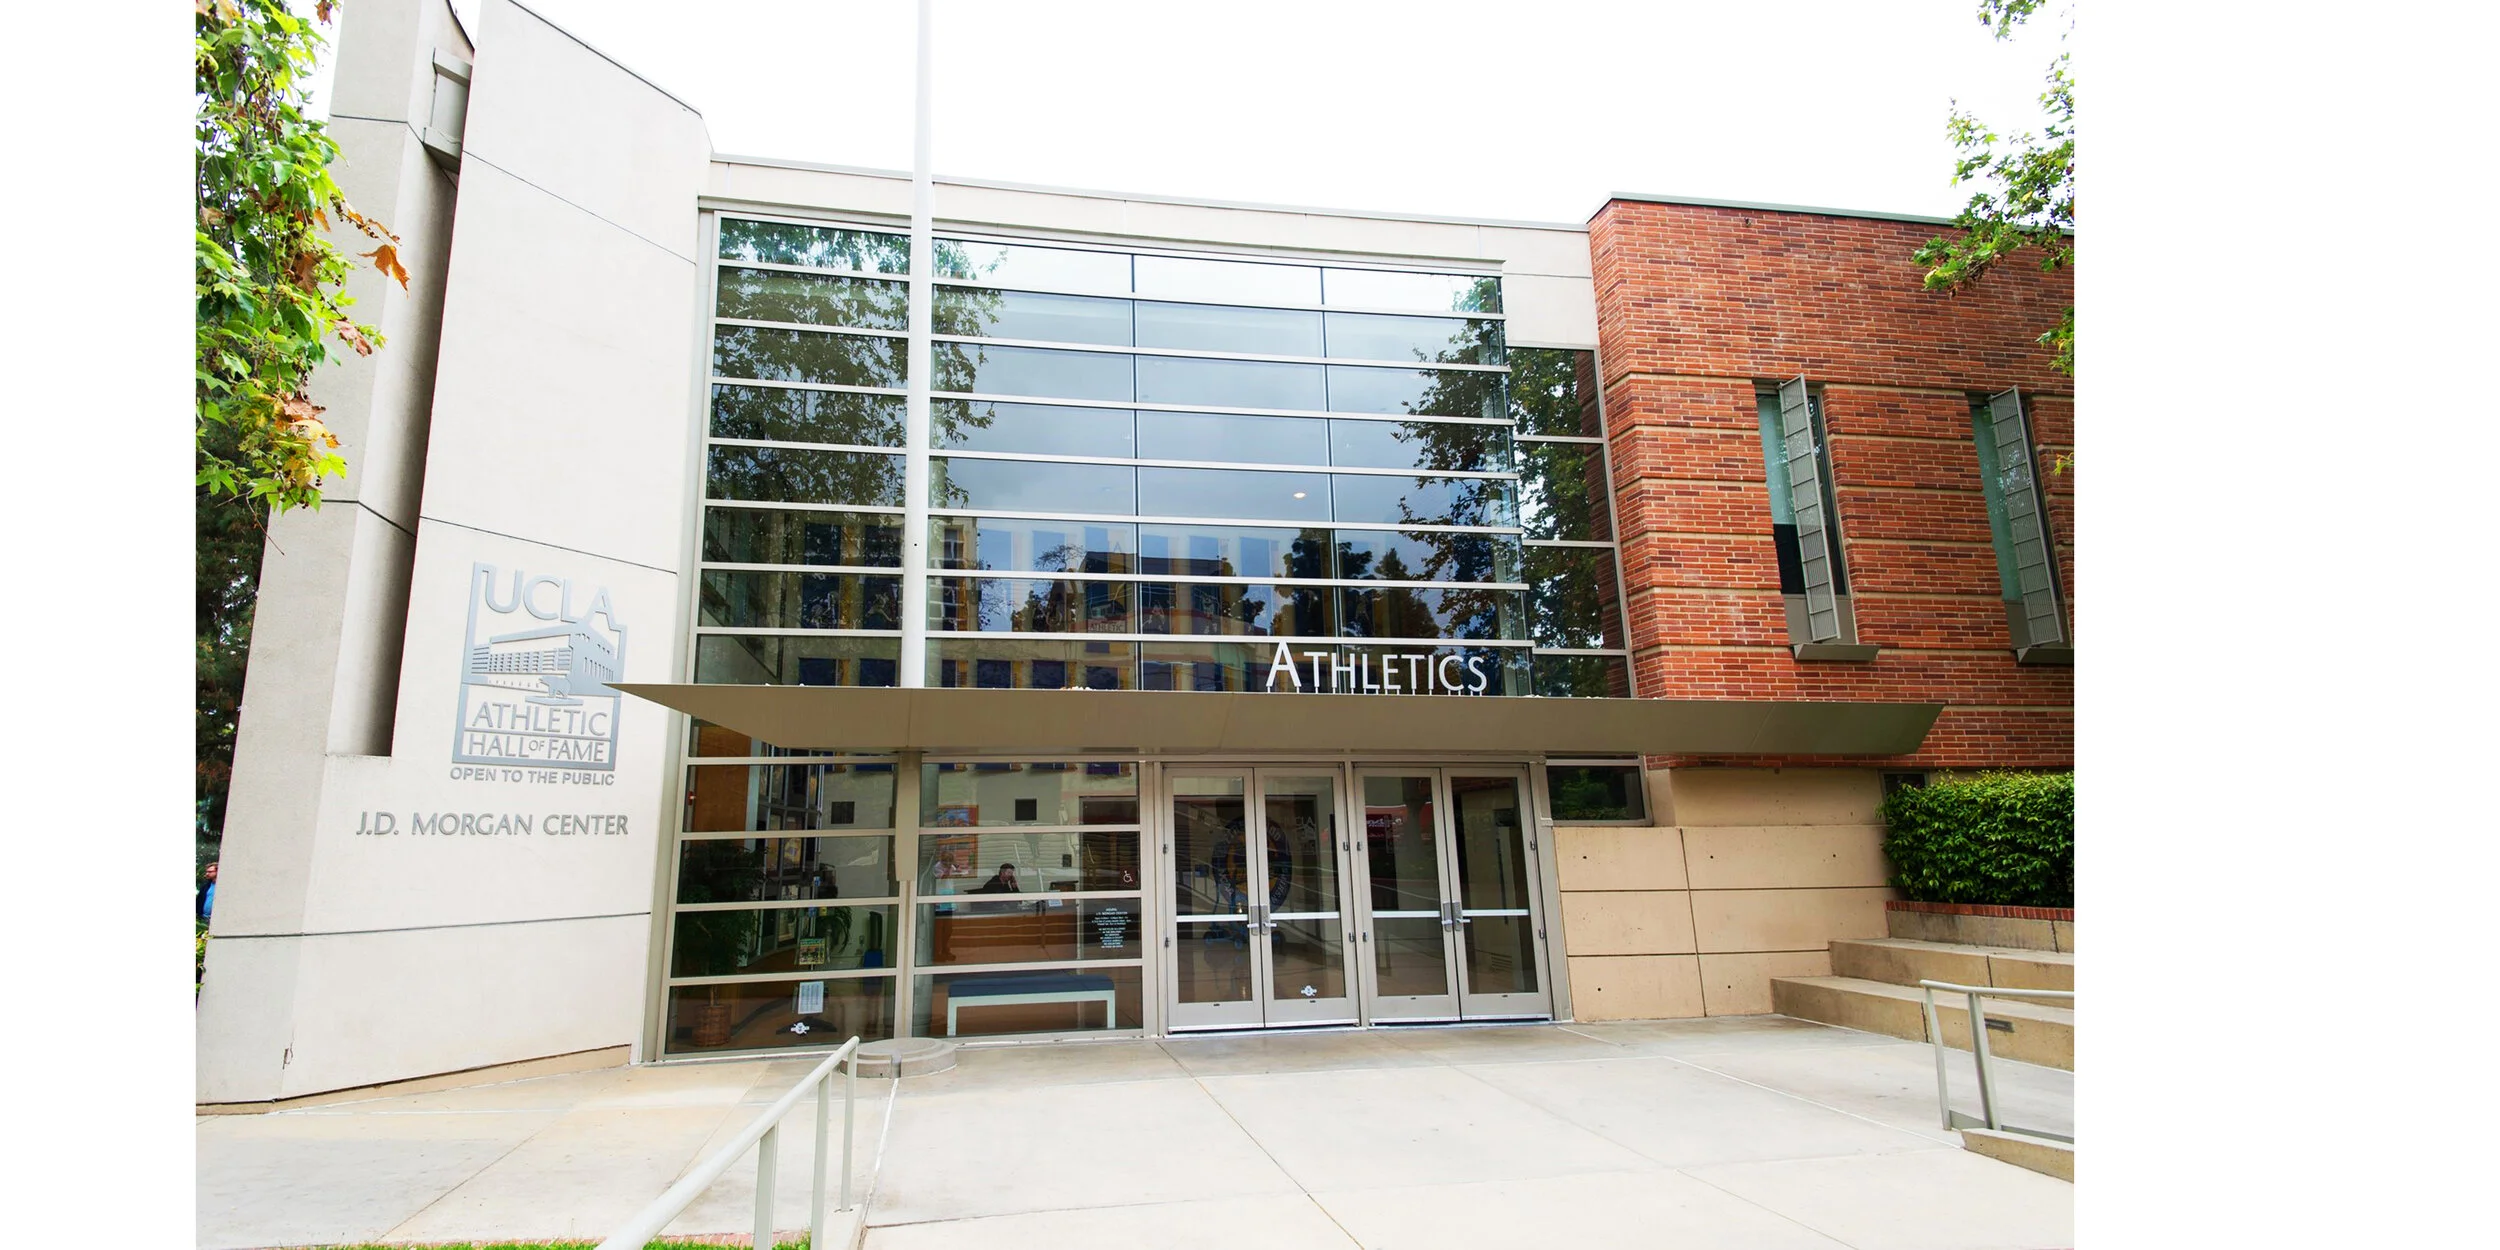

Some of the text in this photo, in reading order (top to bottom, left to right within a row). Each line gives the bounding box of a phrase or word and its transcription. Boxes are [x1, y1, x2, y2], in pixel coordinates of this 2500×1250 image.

[483, 564, 621, 631] UCLA
[1266, 640, 1488, 692] ATHLETICS
[472, 701, 608, 737] ATHLETIC
[469, 733, 604, 762] HALL OF FAME
[450, 767, 615, 786] OPEN TO THE PUBLIC
[356, 811, 629, 836] J.D. MORGAN CENTER
